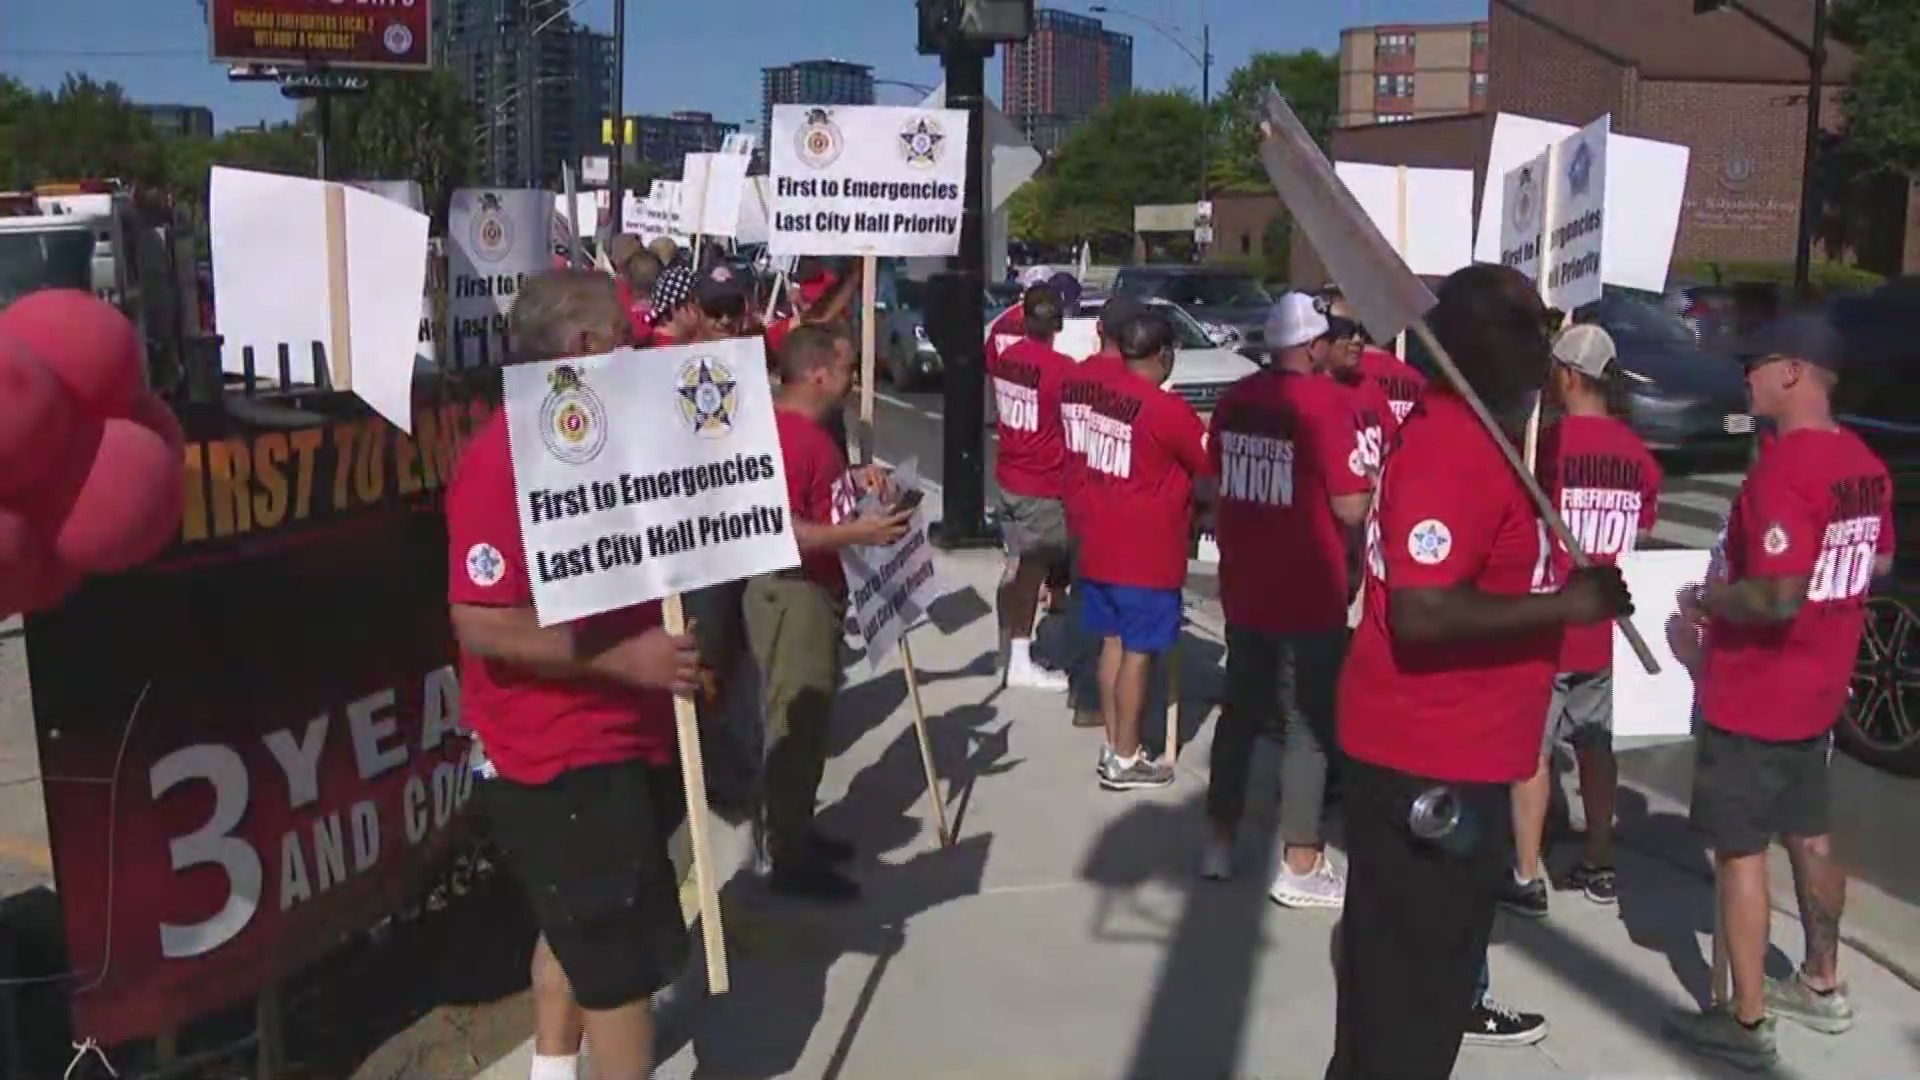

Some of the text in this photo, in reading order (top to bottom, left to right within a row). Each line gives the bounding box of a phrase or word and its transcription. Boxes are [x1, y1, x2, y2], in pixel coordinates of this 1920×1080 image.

[777, 177, 958, 200] First to Emergencies
[775, 211, 957, 234] Last City Hall Priority
[456, 273, 493, 298] First
[497, 273, 514, 296] to
[1561, 251, 1601, 286] Priority
[182, 428, 322, 543] IRST
[334, 418, 388, 511] TO
[528, 452, 775, 524] First to Emergencies
[1561, 487, 1642, 511] FIREFIGHTERS
[536, 504, 784, 584] Last City Hall Priority
[149, 665, 460, 958] 3 YEA
[279, 750, 474, 912] AND COU
